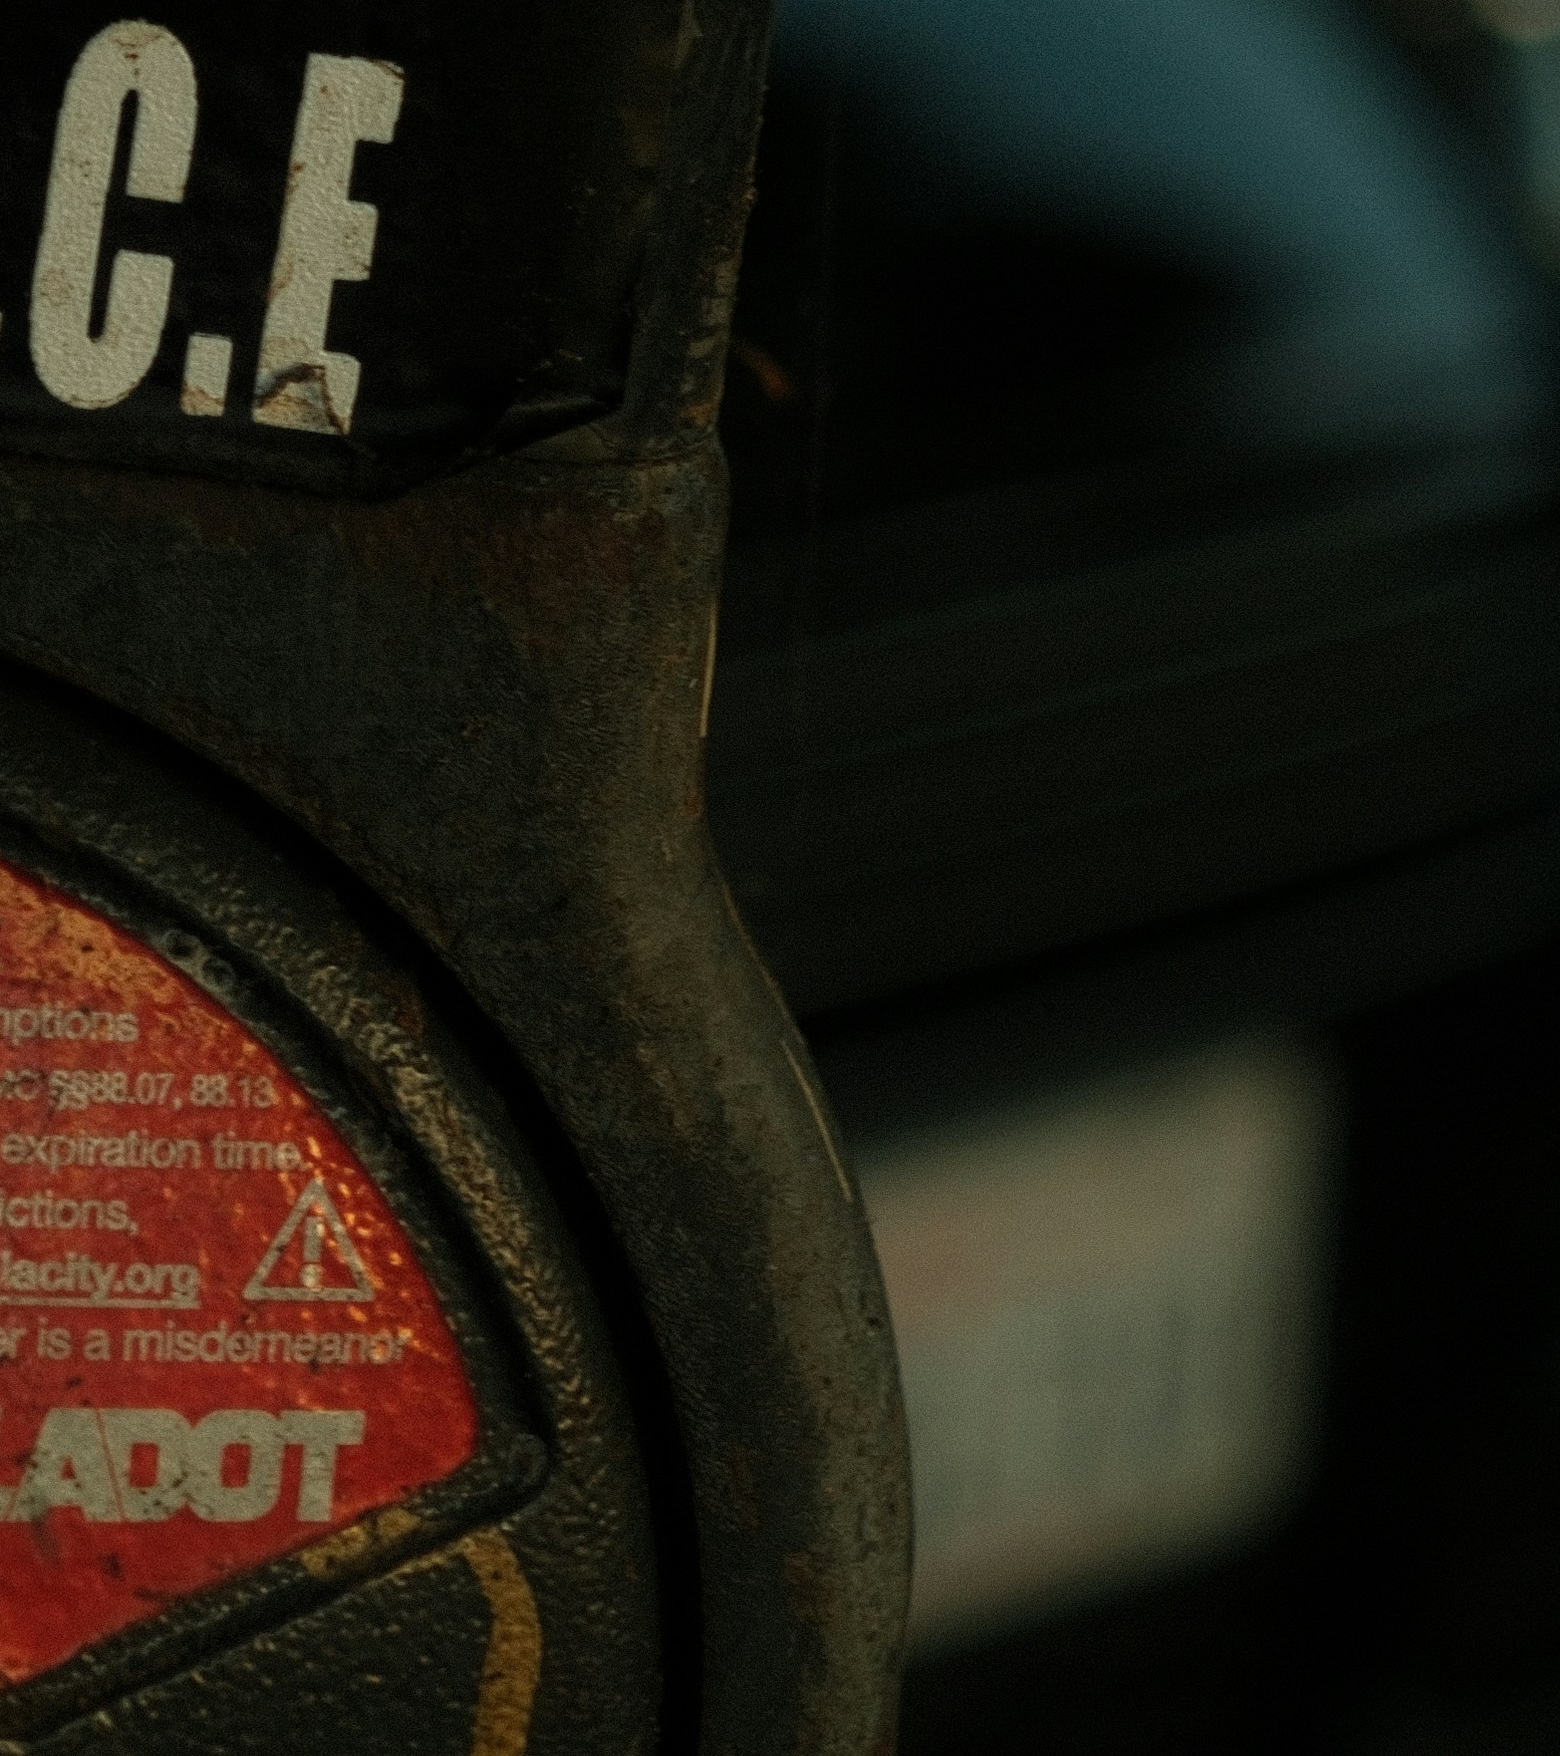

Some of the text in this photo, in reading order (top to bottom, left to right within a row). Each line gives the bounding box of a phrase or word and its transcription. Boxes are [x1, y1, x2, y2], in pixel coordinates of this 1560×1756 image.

[0, 1131, 203, 1171] expiration
[212, 1131, 310, 1174] time.
[37, 1318, 73, 1360] is
[82, 1327, 111, 1362] a
